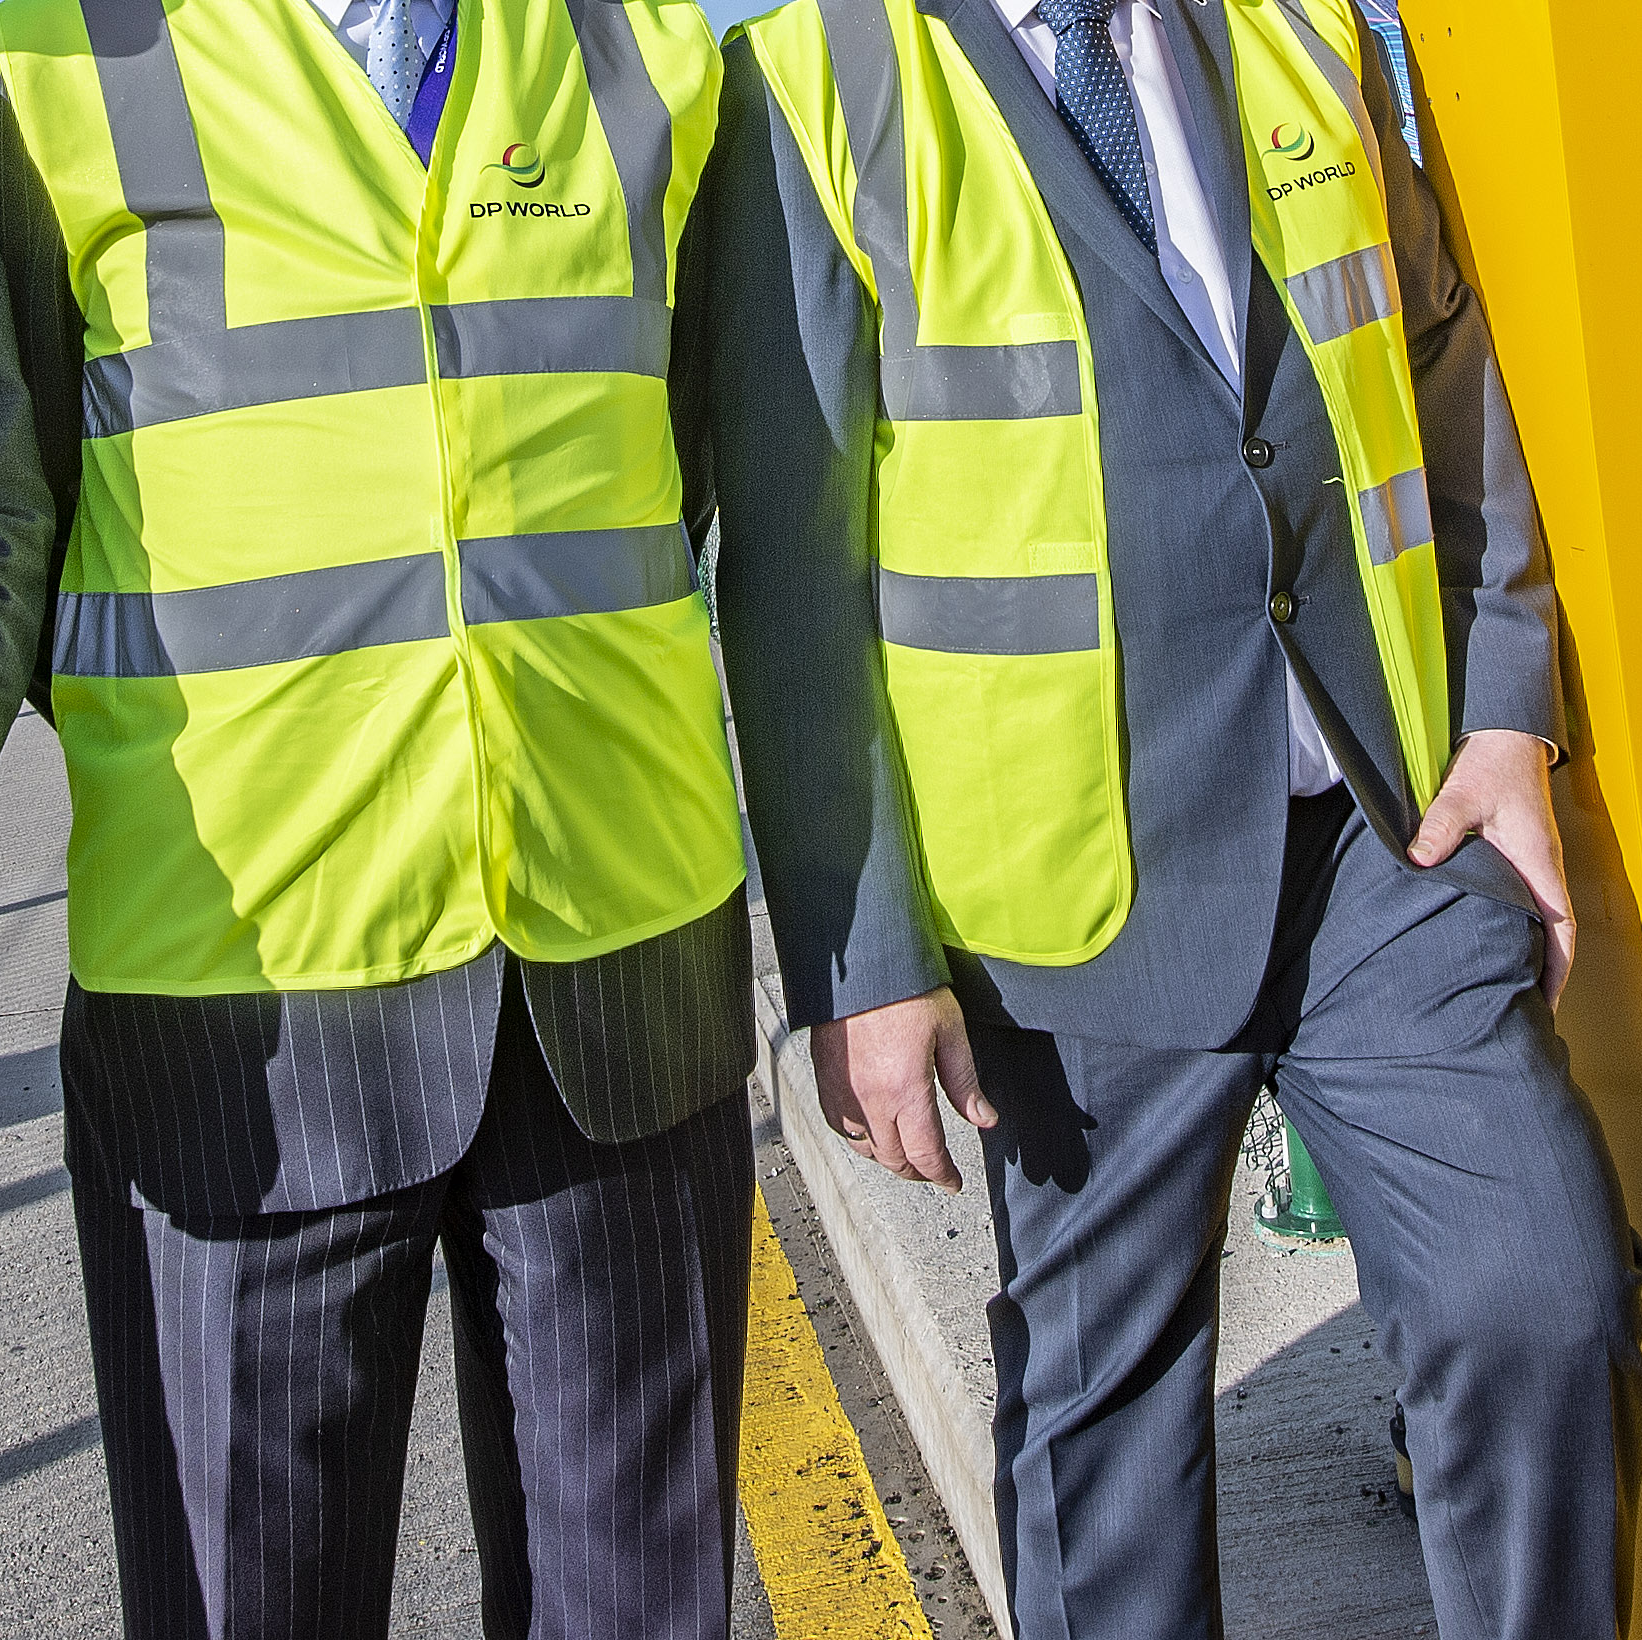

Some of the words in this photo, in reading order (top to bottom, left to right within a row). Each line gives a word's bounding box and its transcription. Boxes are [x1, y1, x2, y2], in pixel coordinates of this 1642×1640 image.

[1266, 183, 1293, 201] DP
[1294, 162, 1356, 190] WORLD
[469, 203, 503, 220] DP
[505, 201, 591, 218] WORLD
